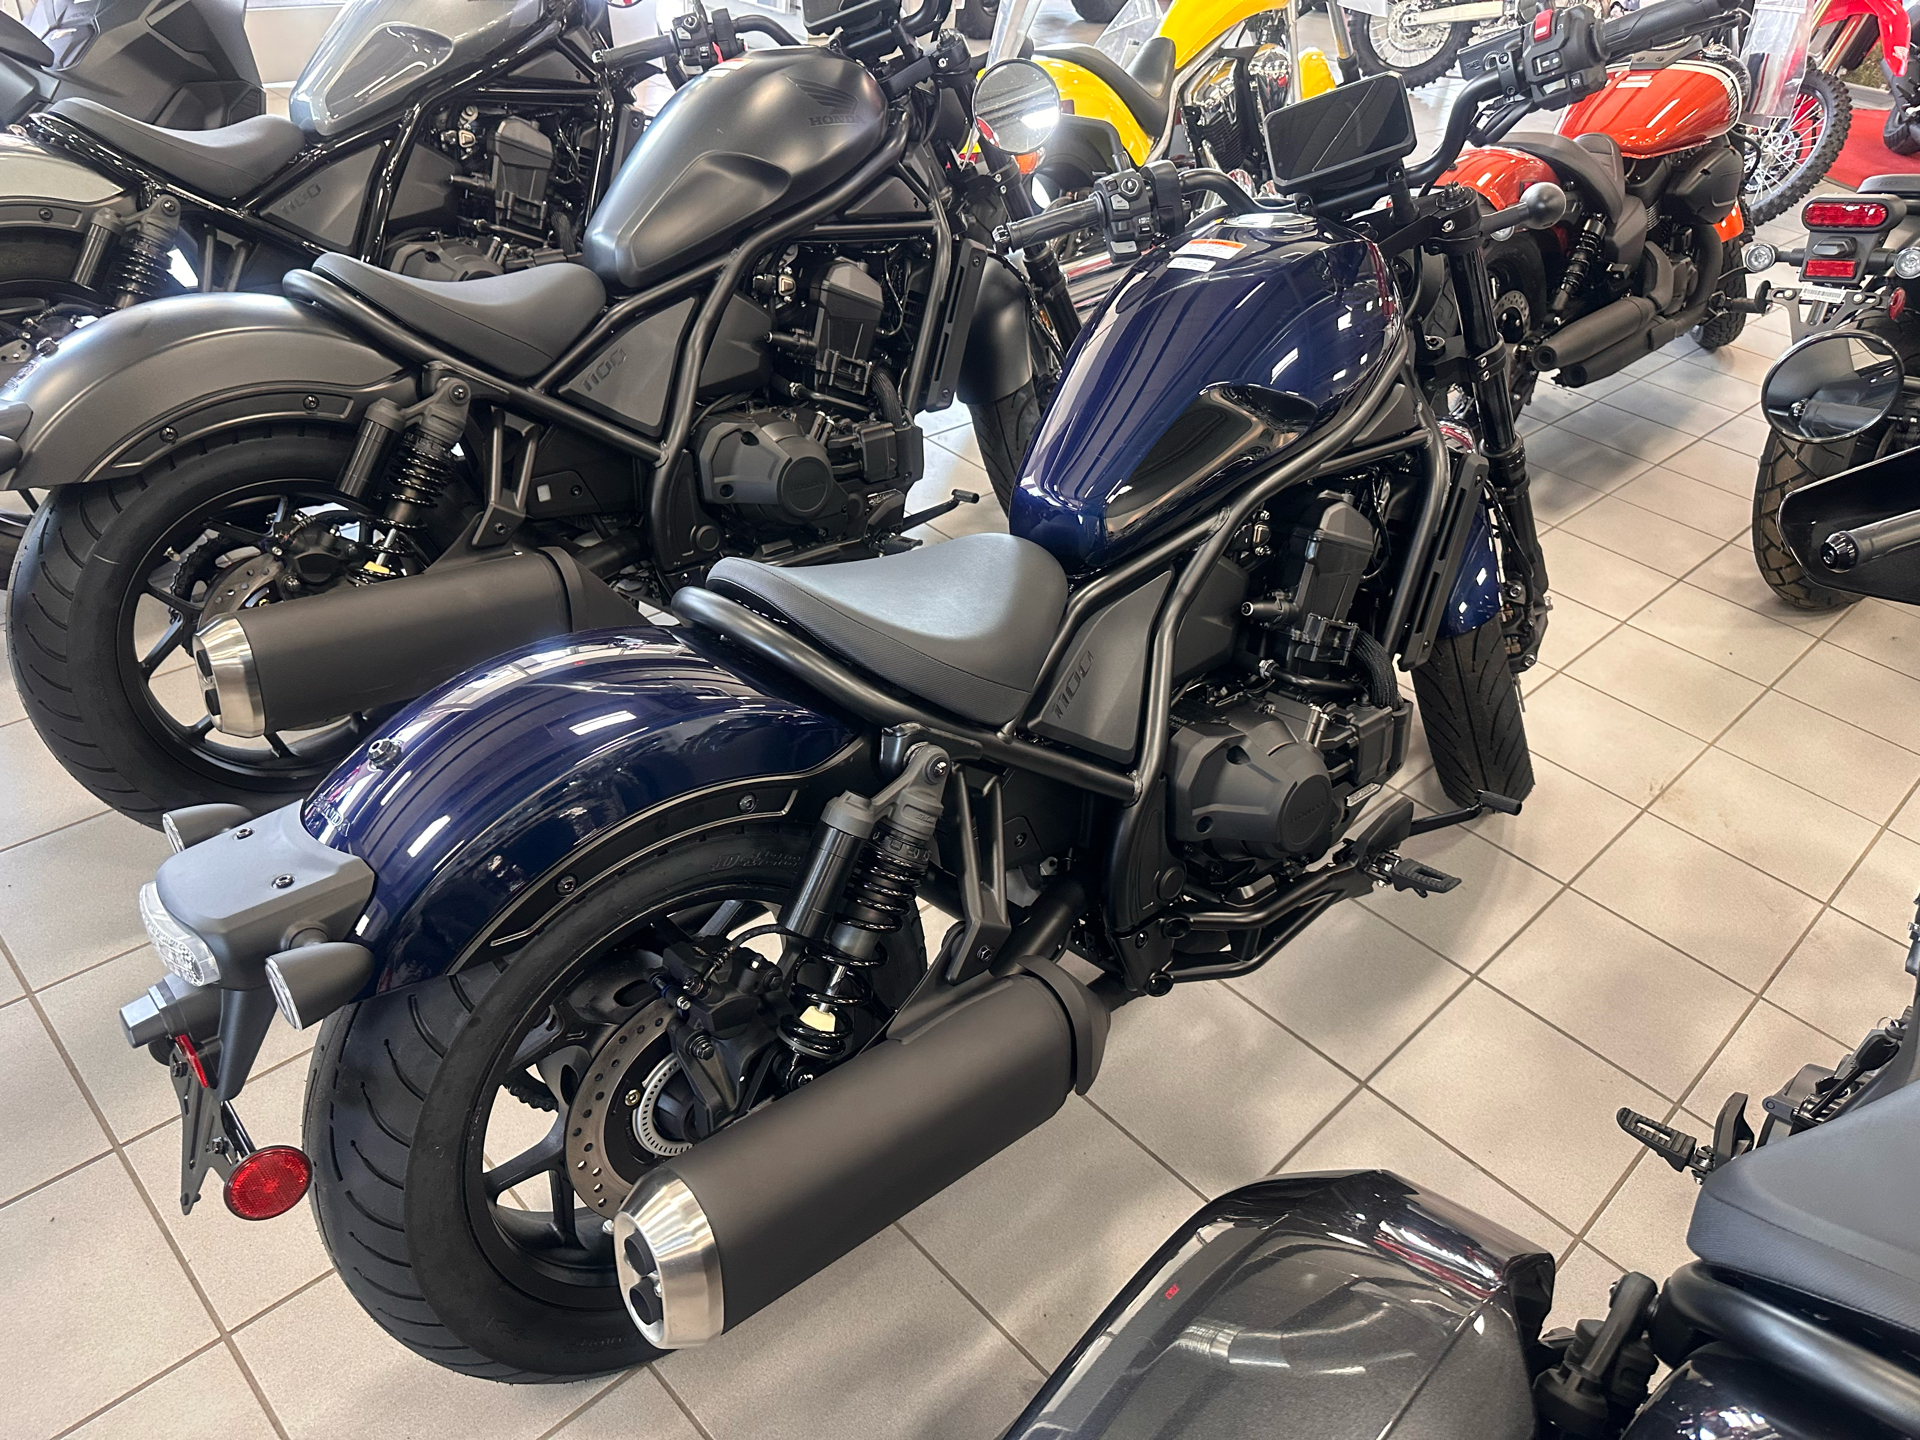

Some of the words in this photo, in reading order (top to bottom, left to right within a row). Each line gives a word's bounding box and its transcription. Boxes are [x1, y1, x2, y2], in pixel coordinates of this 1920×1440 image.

[281, 184, 321, 214] 1100
[582, 348, 627, 392] 1100
[1051, 649, 1094, 720] 1100
